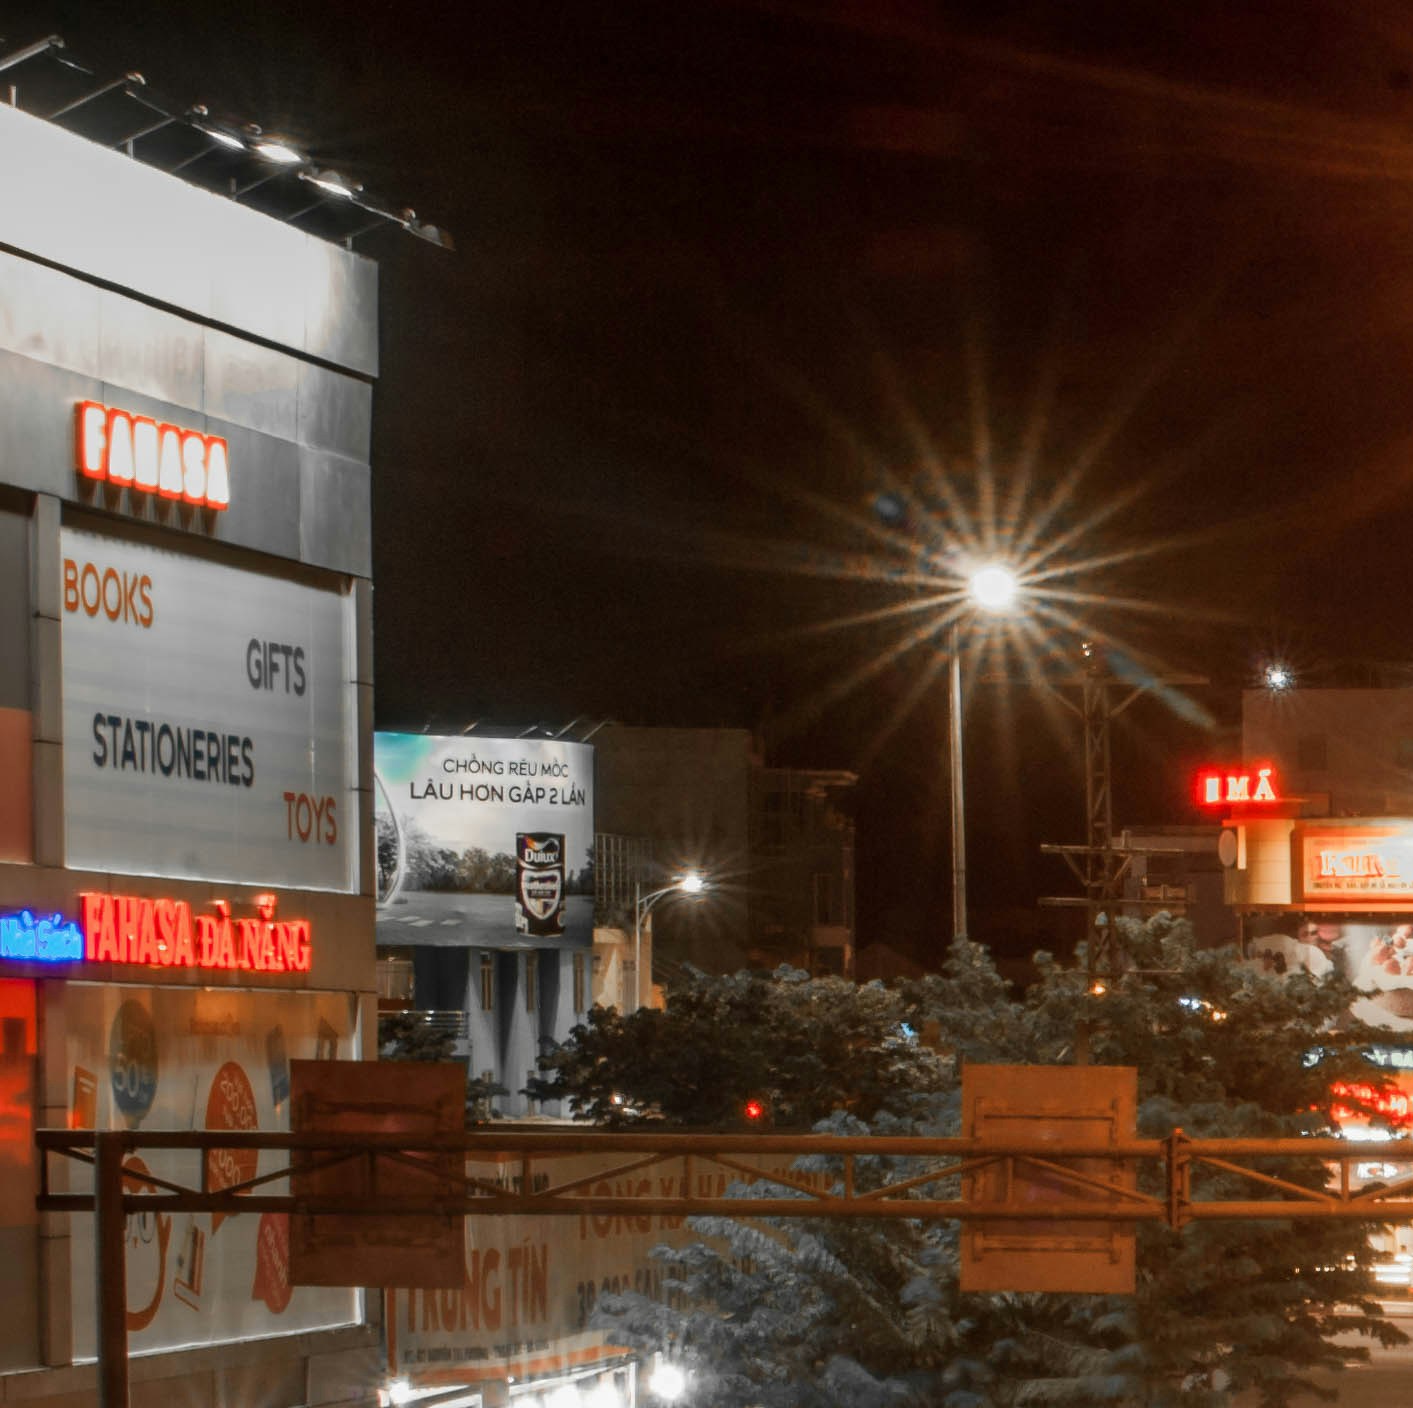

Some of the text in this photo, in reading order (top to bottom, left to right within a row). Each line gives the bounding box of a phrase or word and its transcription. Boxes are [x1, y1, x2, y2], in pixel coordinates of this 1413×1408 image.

[64, 558, 153, 628] BOOKS
[246, 638, 305, 697] GIFTS
[93, 712, 254, 787] STATIONERIES
[283, 791, 337, 845] TOYS
[410, 778, 453, 801] LÂU
[549, 787, 558, 805] 2
[525, 848, 555, 863] Dulux
[81, 891, 195, 968] FAHASA
[196, 899, 237, 970] ĐÀ
